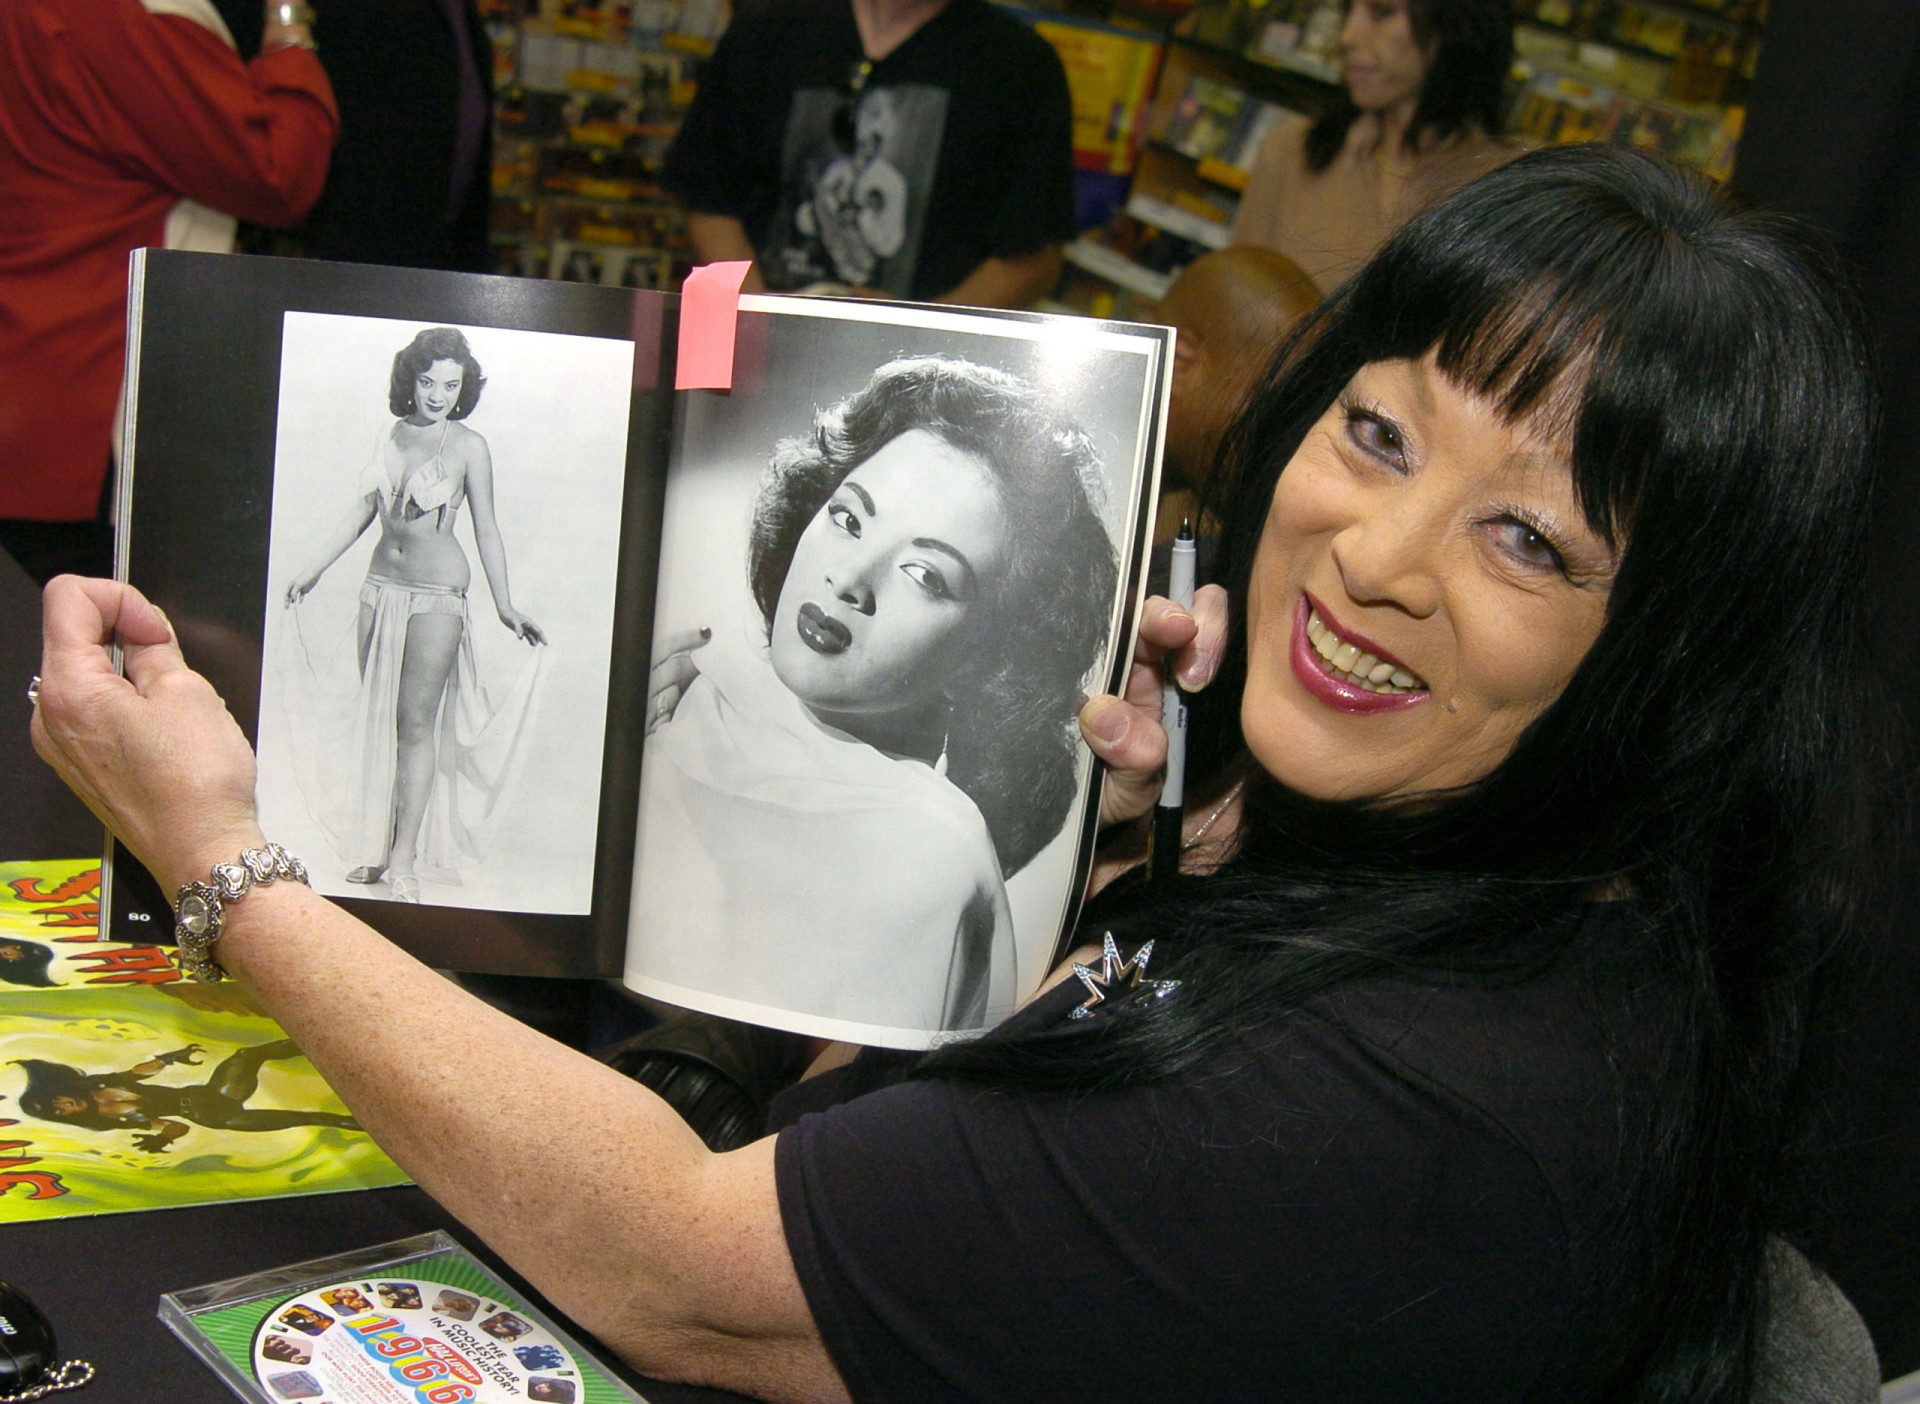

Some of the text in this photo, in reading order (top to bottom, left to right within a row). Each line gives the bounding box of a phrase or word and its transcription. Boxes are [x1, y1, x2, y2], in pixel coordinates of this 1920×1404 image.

[128, 912, 151, 922] 80
[349, 1315, 475, 1404] 1966
[429, 1317, 521, 1396] IN MUSIC HISTORY!
[452, 1324, 521, 1383] COOLEST YEAR
[486, 1341, 508, 1359] THE
